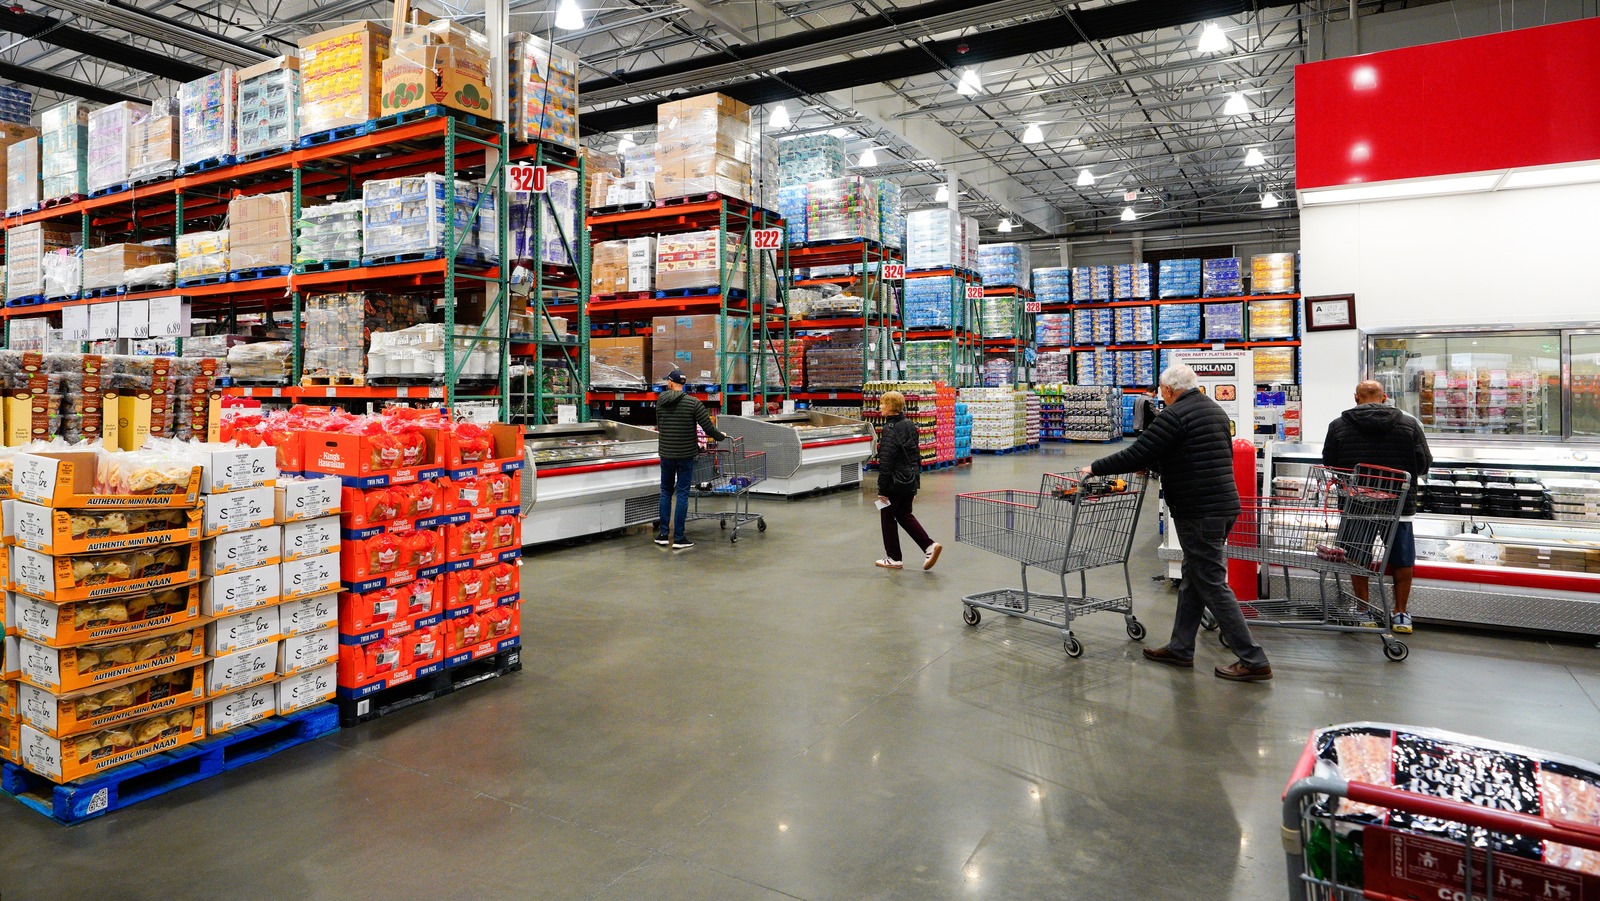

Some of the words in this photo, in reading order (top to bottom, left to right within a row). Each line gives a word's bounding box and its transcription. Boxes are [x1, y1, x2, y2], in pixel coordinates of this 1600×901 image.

[510, 167, 545, 191] 320
[754, 231, 779, 248] 322
[884, 265, 904, 278] 324
[967, 287, 983, 298] 326
[1026, 302, 1040, 312] 328
[104, 328, 117, 338] 9.99
[134, 326, 148, 337] 8.89
[167, 322, 180, 334] 6.89
[74, 330, 88, 340] 11.49
[324, 452, 340, 462] King's
[318, 458, 345, 470] Hawaiian
[88, 541, 126, 550] AUTHENTIC
[128, 538, 144, 546] MINI
[146, 535, 172, 544] NAAN
[89, 587, 126, 597] AUTHENTIC
[128, 583, 145, 591] MINI
[146, 577, 172, 588] NAAN
[90, 627, 128, 638] AUTHENTIC
[130, 624, 146, 632] MINI
[147, 616, 172, 627] NAAN
[93, 667, 132, 682] AUTHENTIC
[134, 662, 150, 672] MINI
[151, 655, 176, 667] NAAN
[92, 711, 131, 726] AUTHENTIC
[132, 705, 150, 715] MINI
[150, 698, 176, 710] NAAN
[95, 751, 134, 770] AUTHENTIC
[135, 746, 152, 757] MINI
[152, 738, 178, 751] NAAN
